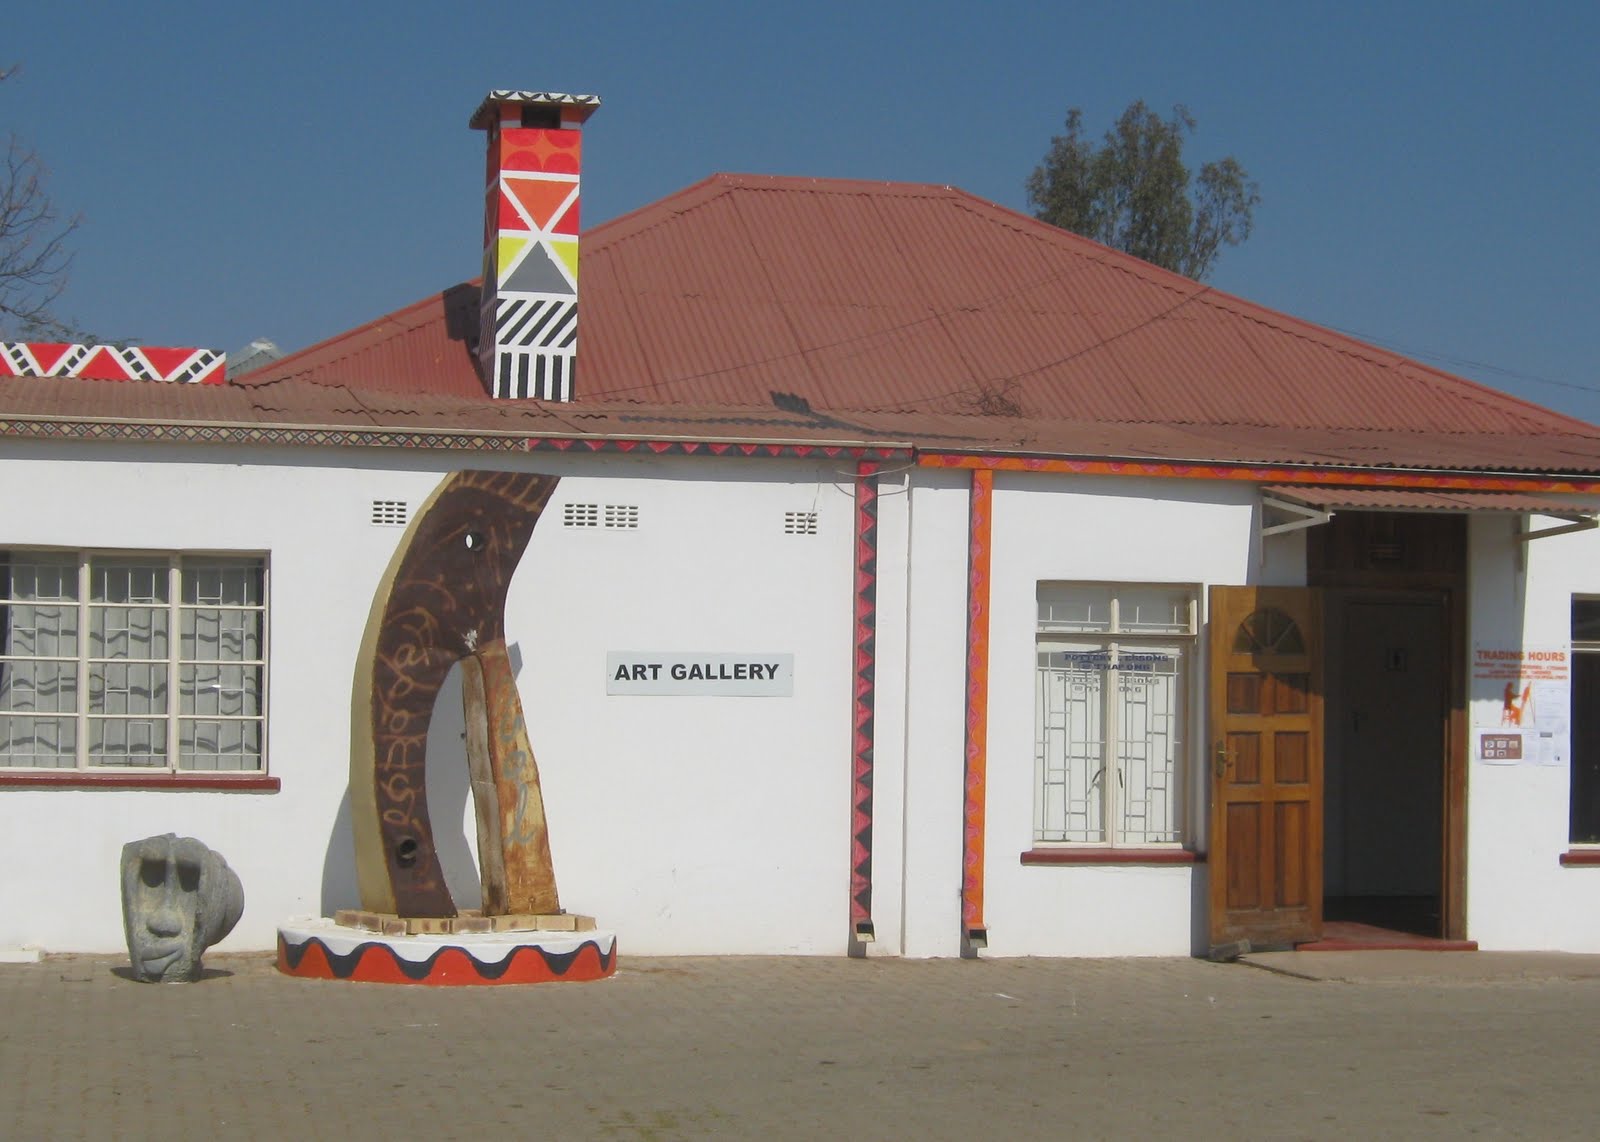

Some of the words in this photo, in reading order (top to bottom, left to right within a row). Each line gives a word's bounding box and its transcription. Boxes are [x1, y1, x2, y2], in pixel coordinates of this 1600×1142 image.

[1477, 650, 1525, 660] TRADING
[1528, 652, 1565, 661] HOURS
[614, 664, 662, 680] ART
[671, 663, 779, 680] GALLERY
